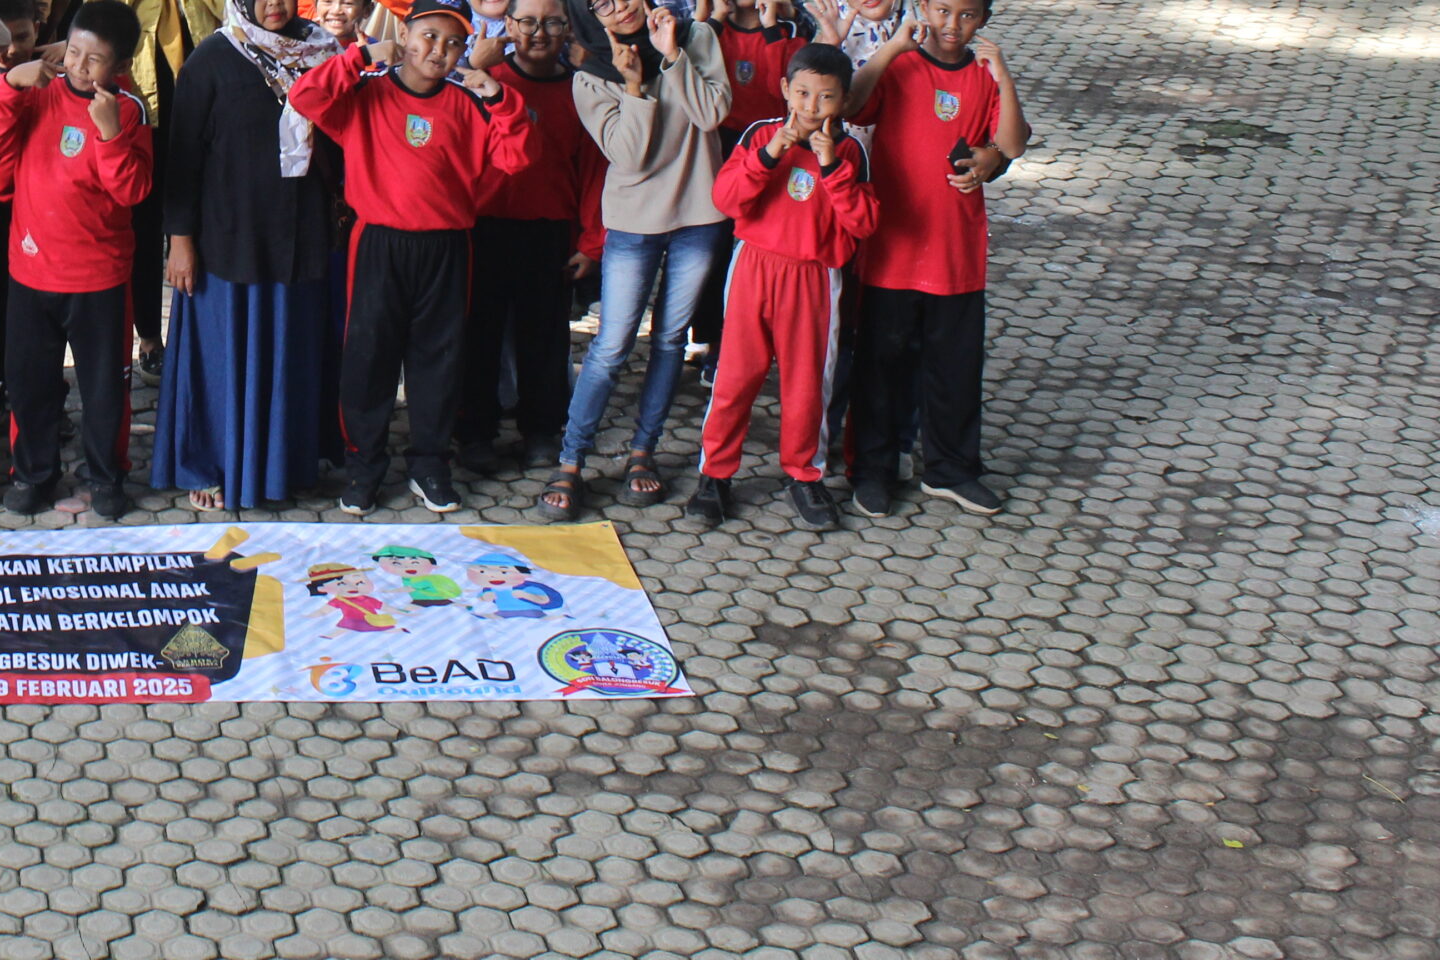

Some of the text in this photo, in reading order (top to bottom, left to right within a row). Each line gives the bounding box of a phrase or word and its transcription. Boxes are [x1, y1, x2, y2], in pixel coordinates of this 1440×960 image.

[47, 555, 194, 575] KETRAMPILAN
[20, 583, 146, 602] EMOSIONAL
[150, 583, 211, 599] ANAK
[58, 608, 220, 631] BERKELOMPOK
[371, 659, 516, 683] BeAD
[17, 679, 127, 697] FEBRUARI
[133, 678, 193, 696] 2025
